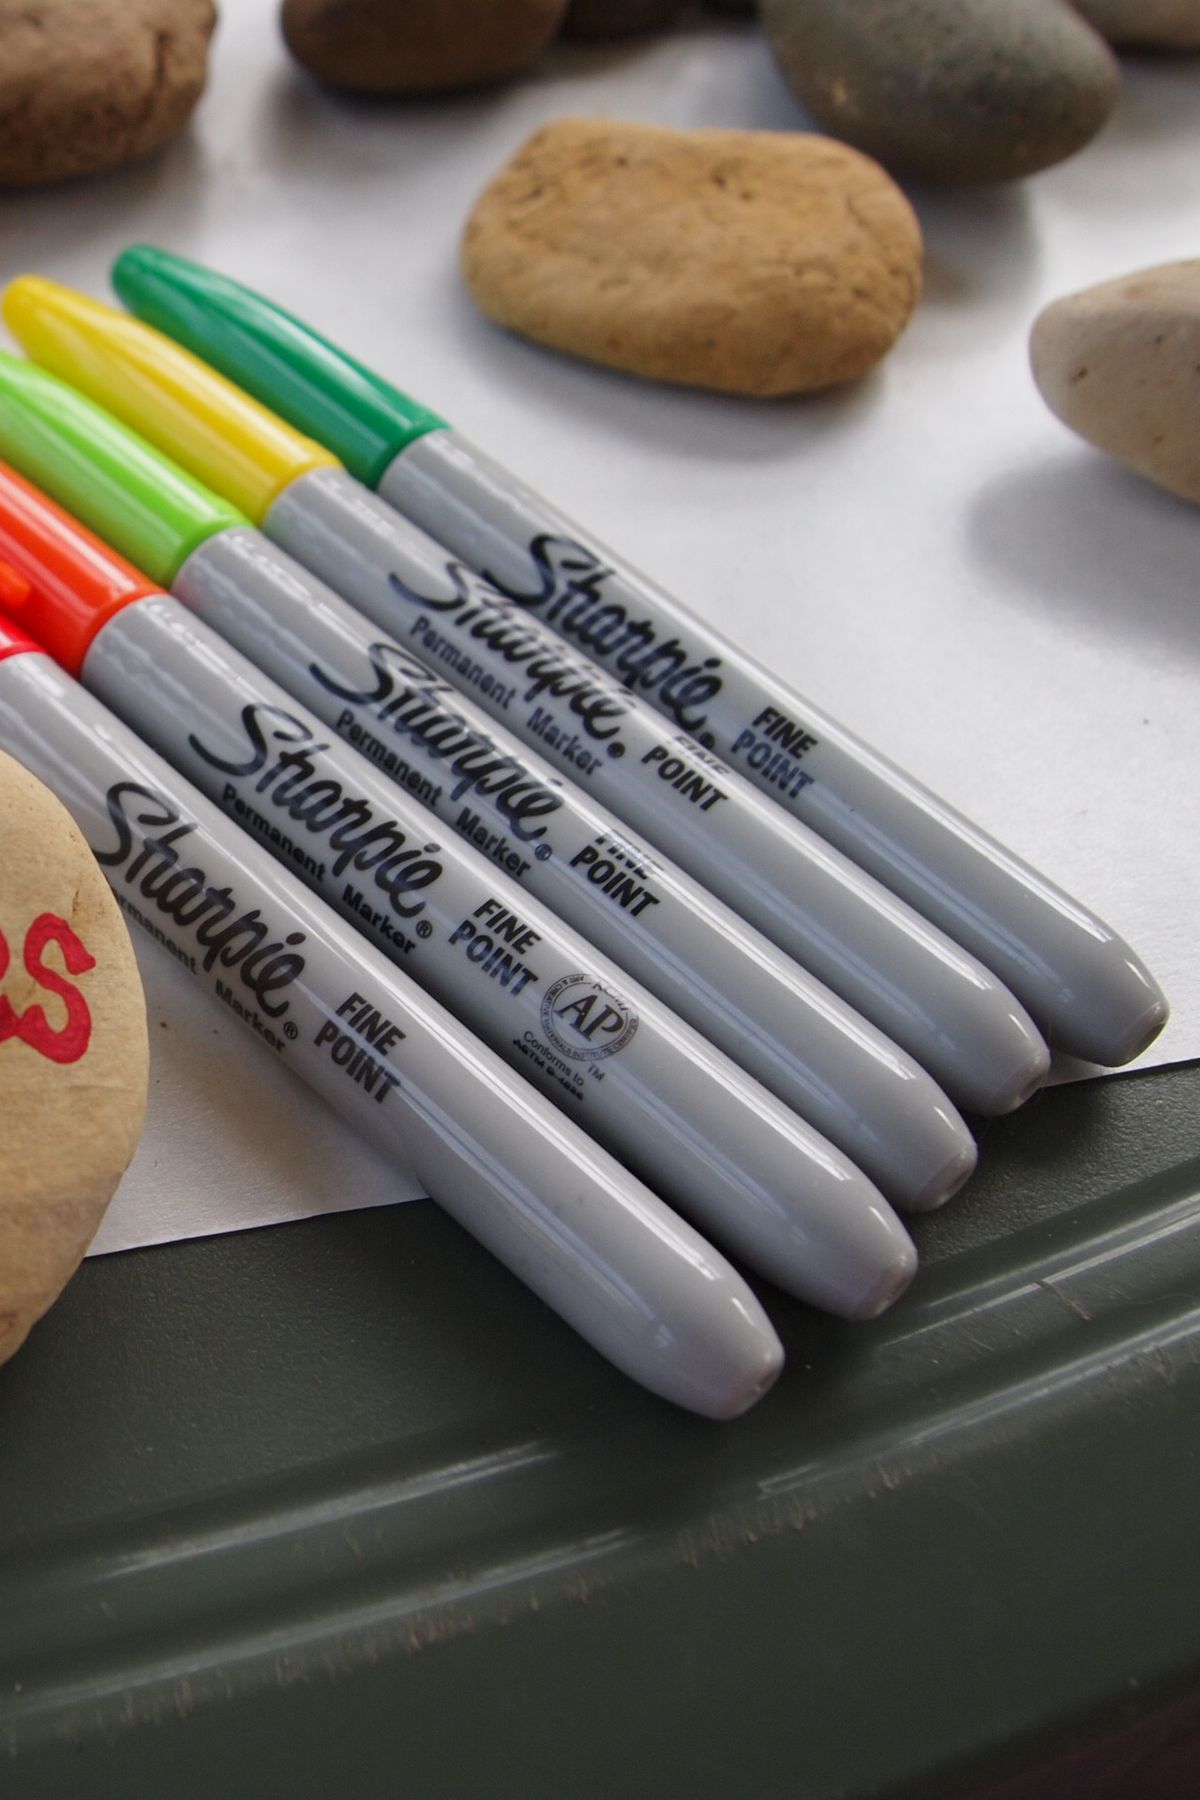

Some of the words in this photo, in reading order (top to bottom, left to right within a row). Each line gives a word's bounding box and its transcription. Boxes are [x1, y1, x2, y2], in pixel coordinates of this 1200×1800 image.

[482, 534, 723, 731] Sharpie
[410, 615, 517, 710] Permanent
[526, 706, 603, 776] Marker
[752, 706, 818, 760] FINE
[309, 643, 563, 841] Sharpie
[641, 745, 728, 811] POINT
[731, 728, 815, 799] POINT
[189, 702, 444, 918] Sharpie
[336, 709, 444, 807] Permanent
[455, 807, 532, 878] Marker
[95, 781, 307, 1018] Sharpie
[222, 782, 326, 883] Permanent
[342, 884, 417, 956] Marker
[569, 846, 661, 917] POINT
[448, 920, 539, 997] POINT
[473, 898, 542, 955] FINE
[110, 887, 200, 976] rmanent
[215, 979, 287, 1052] Marker
[336, 992, 407, 1056] FINE
[523, 1030, 572, 1077] Conforms
[573, 1073, 585, 1086] to
[554, 994, 624, 1042] AP
[314, 1019, 401, 1104] POINT
